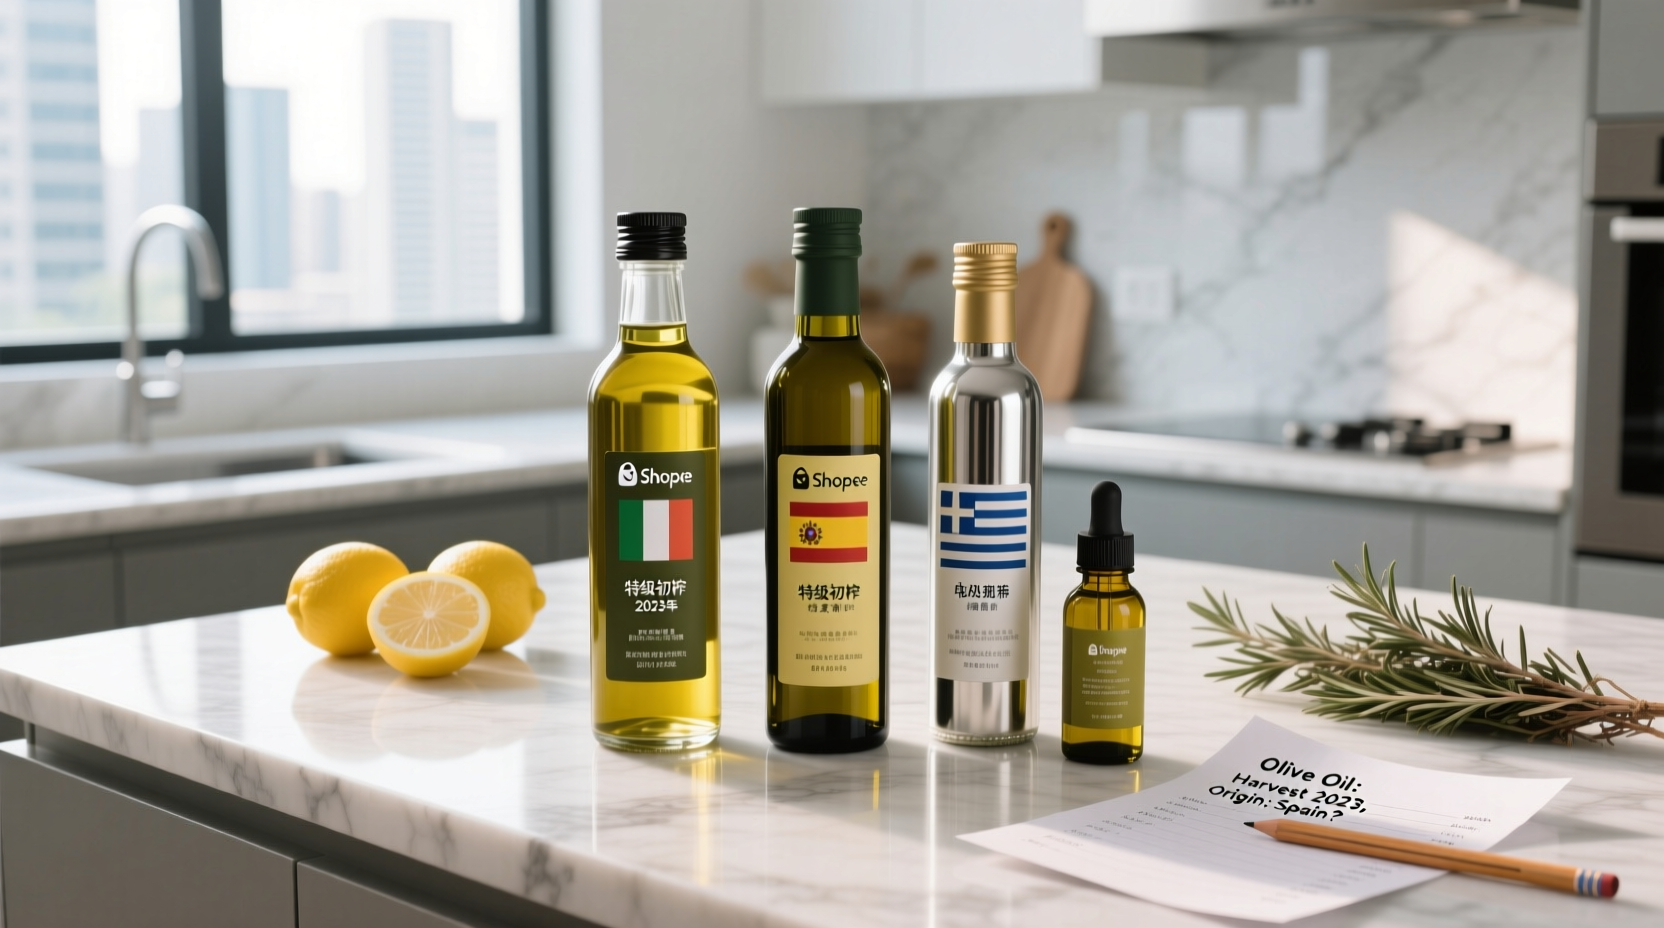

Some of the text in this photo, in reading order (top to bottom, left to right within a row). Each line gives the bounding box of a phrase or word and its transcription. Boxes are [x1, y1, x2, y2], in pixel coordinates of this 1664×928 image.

[812, 471, 868, 492] Shopee
[1260, 757, 1362, 793] Olive Oil:
[1208, 785, 1272, 808] Origin:
[1231, 772, 1367, 814] Harvest 2023,
